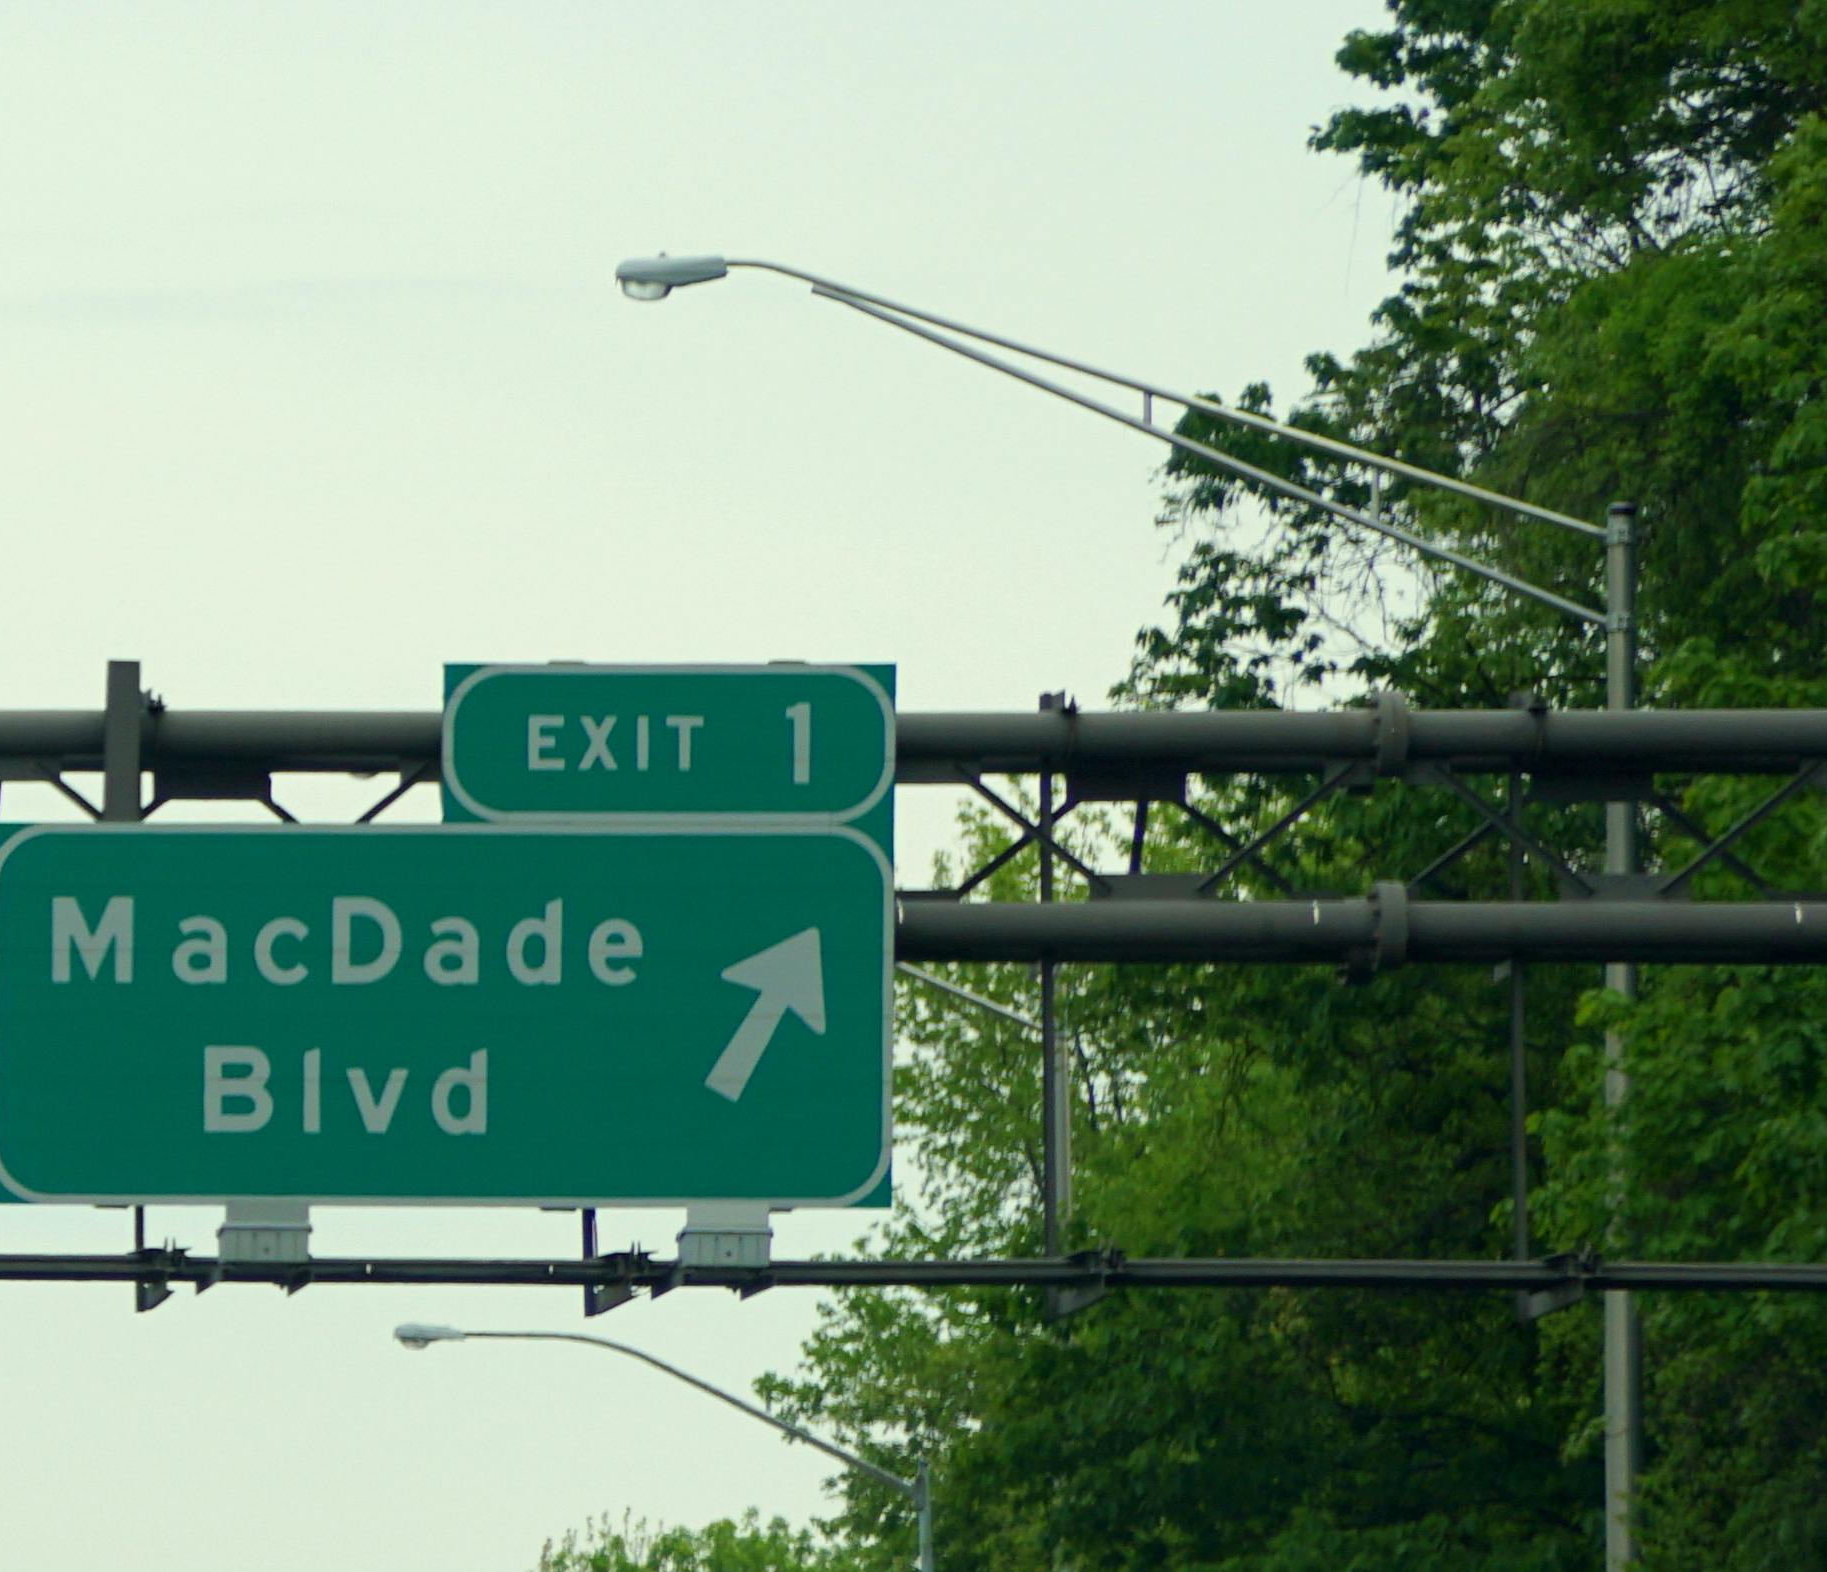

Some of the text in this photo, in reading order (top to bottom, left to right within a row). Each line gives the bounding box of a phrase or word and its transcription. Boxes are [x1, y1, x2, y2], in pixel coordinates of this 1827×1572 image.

[527, 702, 811, 785] EXIT 1
[51, 896, 644, 986] MacDade
[203, 1046, 487, 1134] Blvd
